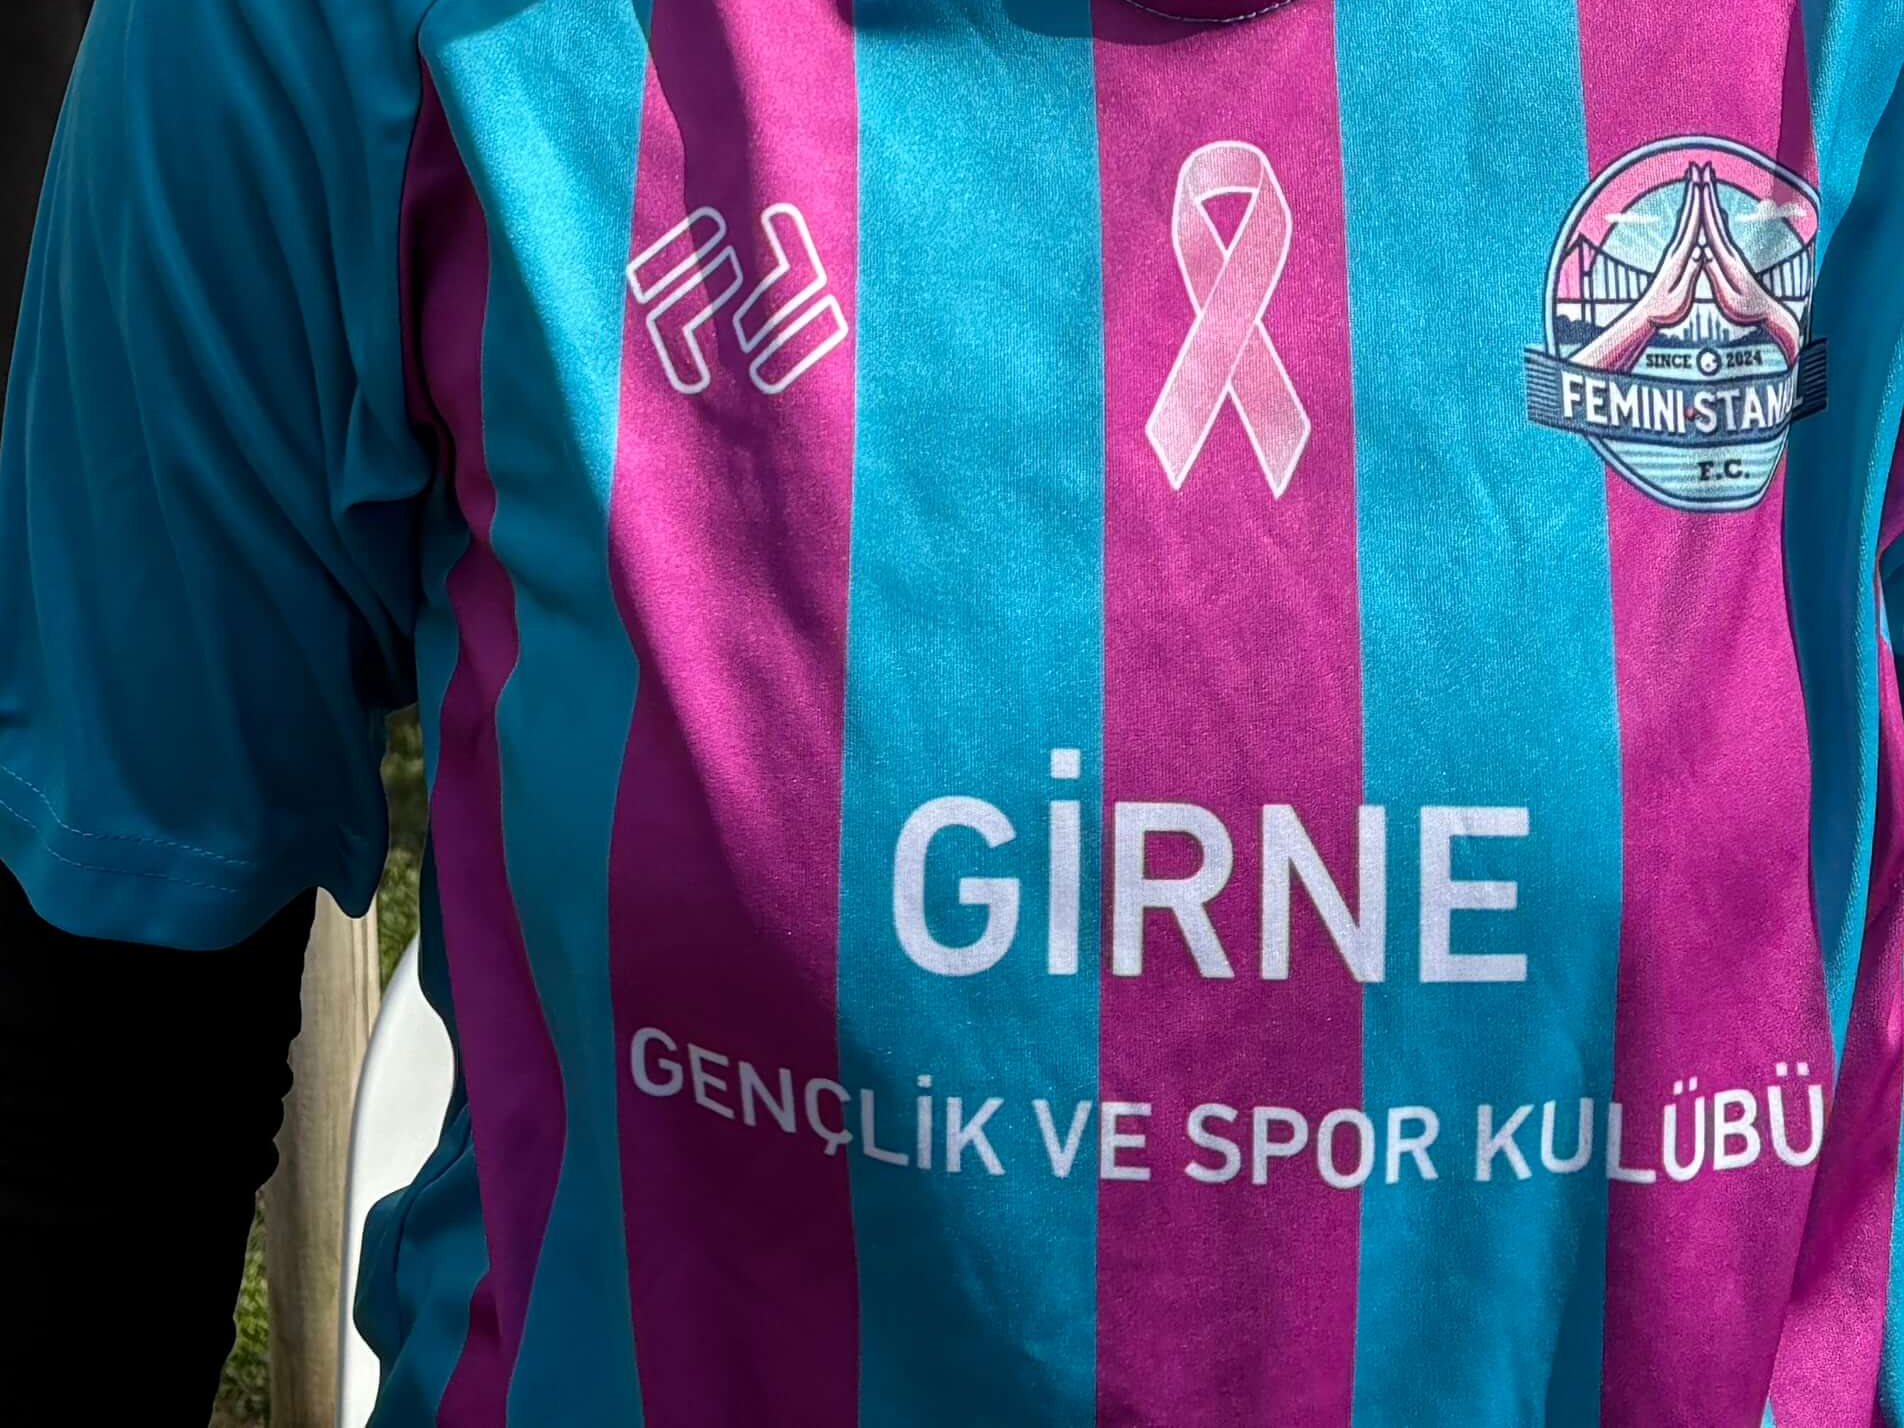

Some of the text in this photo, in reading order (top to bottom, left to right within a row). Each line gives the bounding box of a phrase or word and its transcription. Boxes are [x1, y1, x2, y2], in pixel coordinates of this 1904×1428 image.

[1646, 350, 1763, 370] SINCE 2024
[892, 747, 1530, 983] GİRNE
[629, 1026, 1825, 1190] GENÇLİK VE SPOR KULÜBÜ
